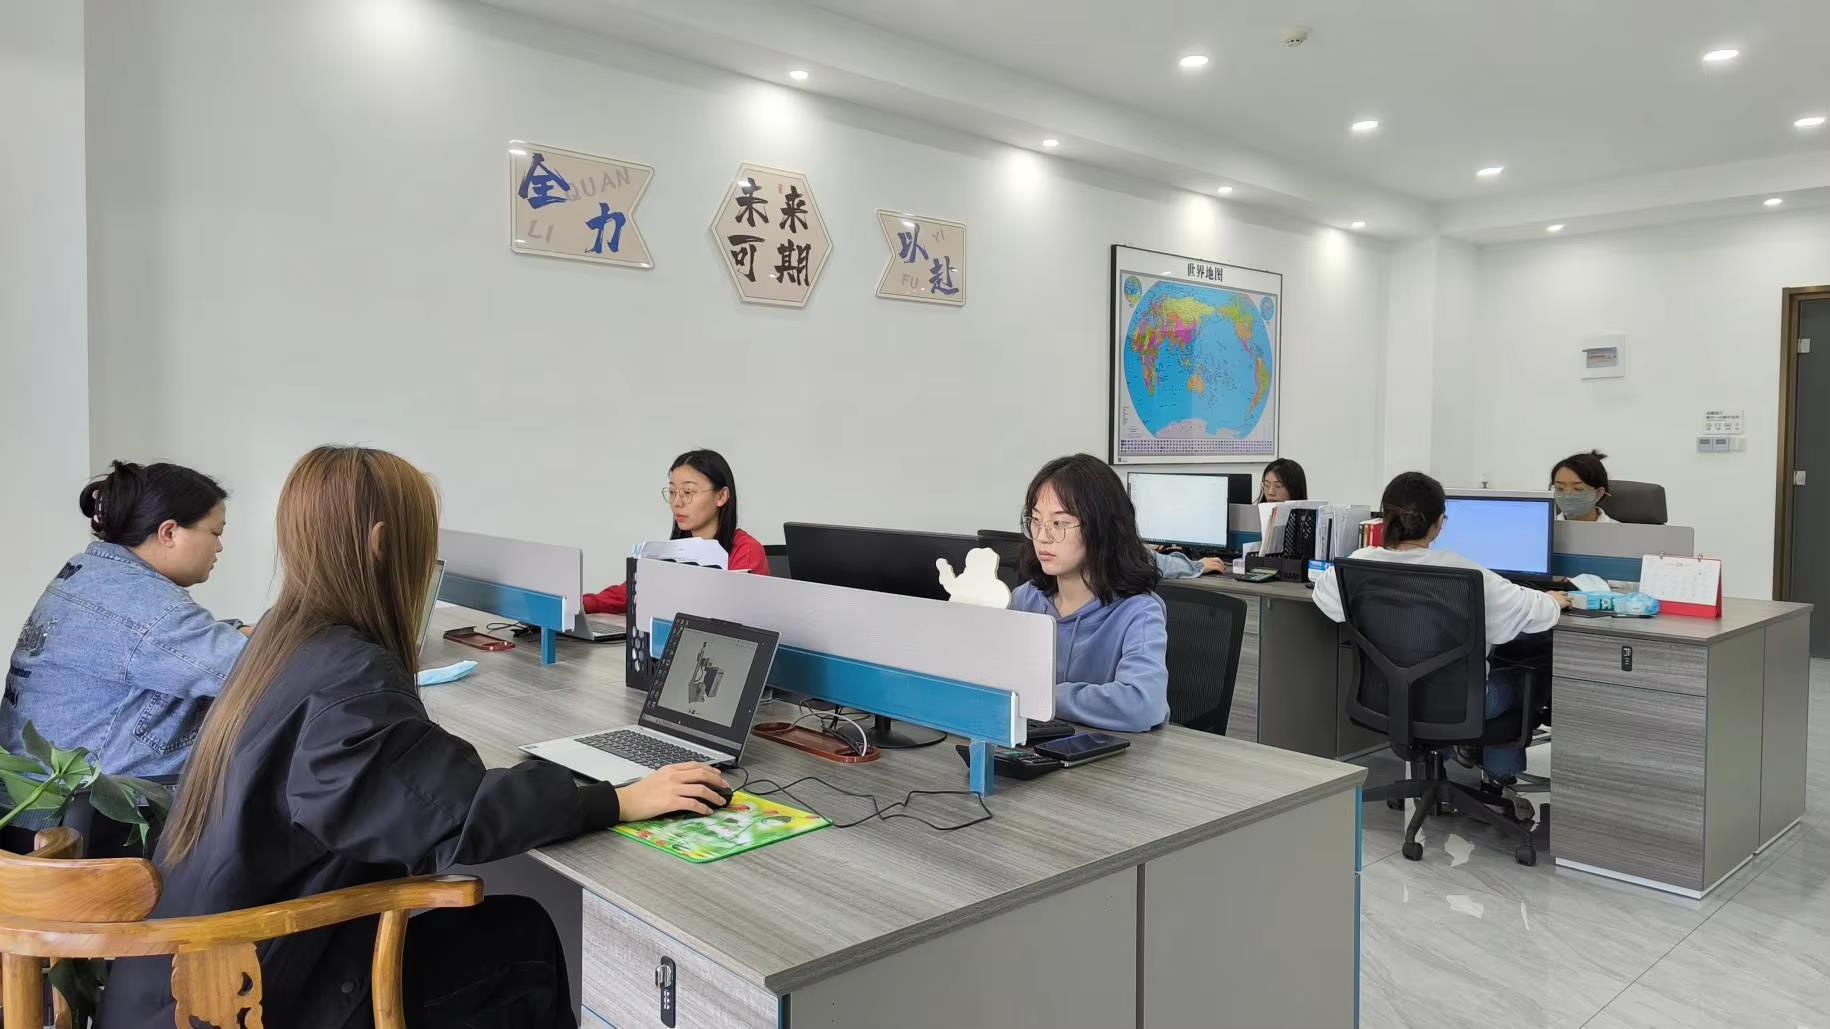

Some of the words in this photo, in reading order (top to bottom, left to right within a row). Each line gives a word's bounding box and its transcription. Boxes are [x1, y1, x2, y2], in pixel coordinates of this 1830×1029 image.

[565, 167, 631, 202] QUAN
[734, 176, 809, 234] 未来
[527, 219, 555, 243] LI
[727, 234, 812, 287] 可期
[1187, 262, 1223, 282] 世界地图
[901, 273, 919, 289] FU
